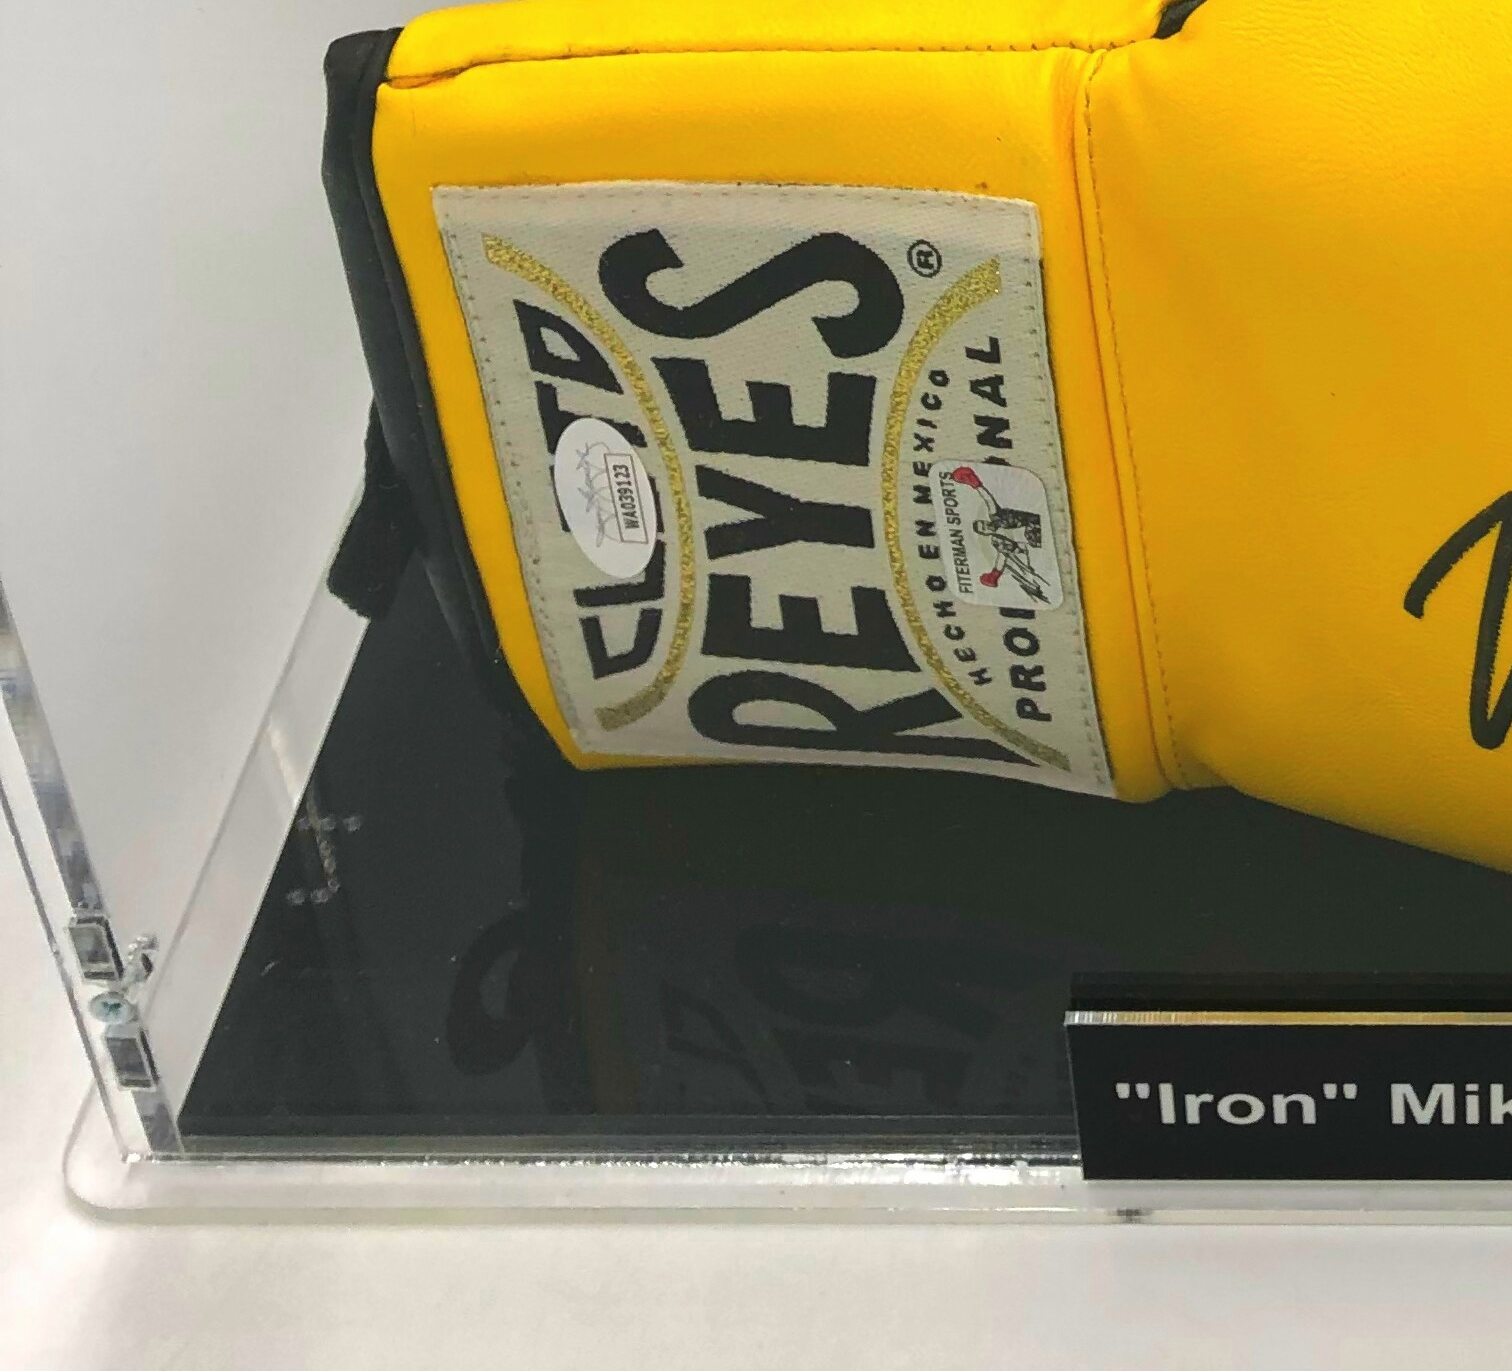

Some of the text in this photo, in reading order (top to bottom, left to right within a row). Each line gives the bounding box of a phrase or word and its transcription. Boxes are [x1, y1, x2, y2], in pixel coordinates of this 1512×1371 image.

[513, 299, 667, 680] CLTO
[597, 228, 1041, 767] REYES
[612, 463, 640, 530] WA039123
[912, 368, 993, 687] HECHO EN MEXICO
[938, 470, 974, 595] FITERMAN SPORTS
[1114, 1081, 1359, 1126] "Iron"
